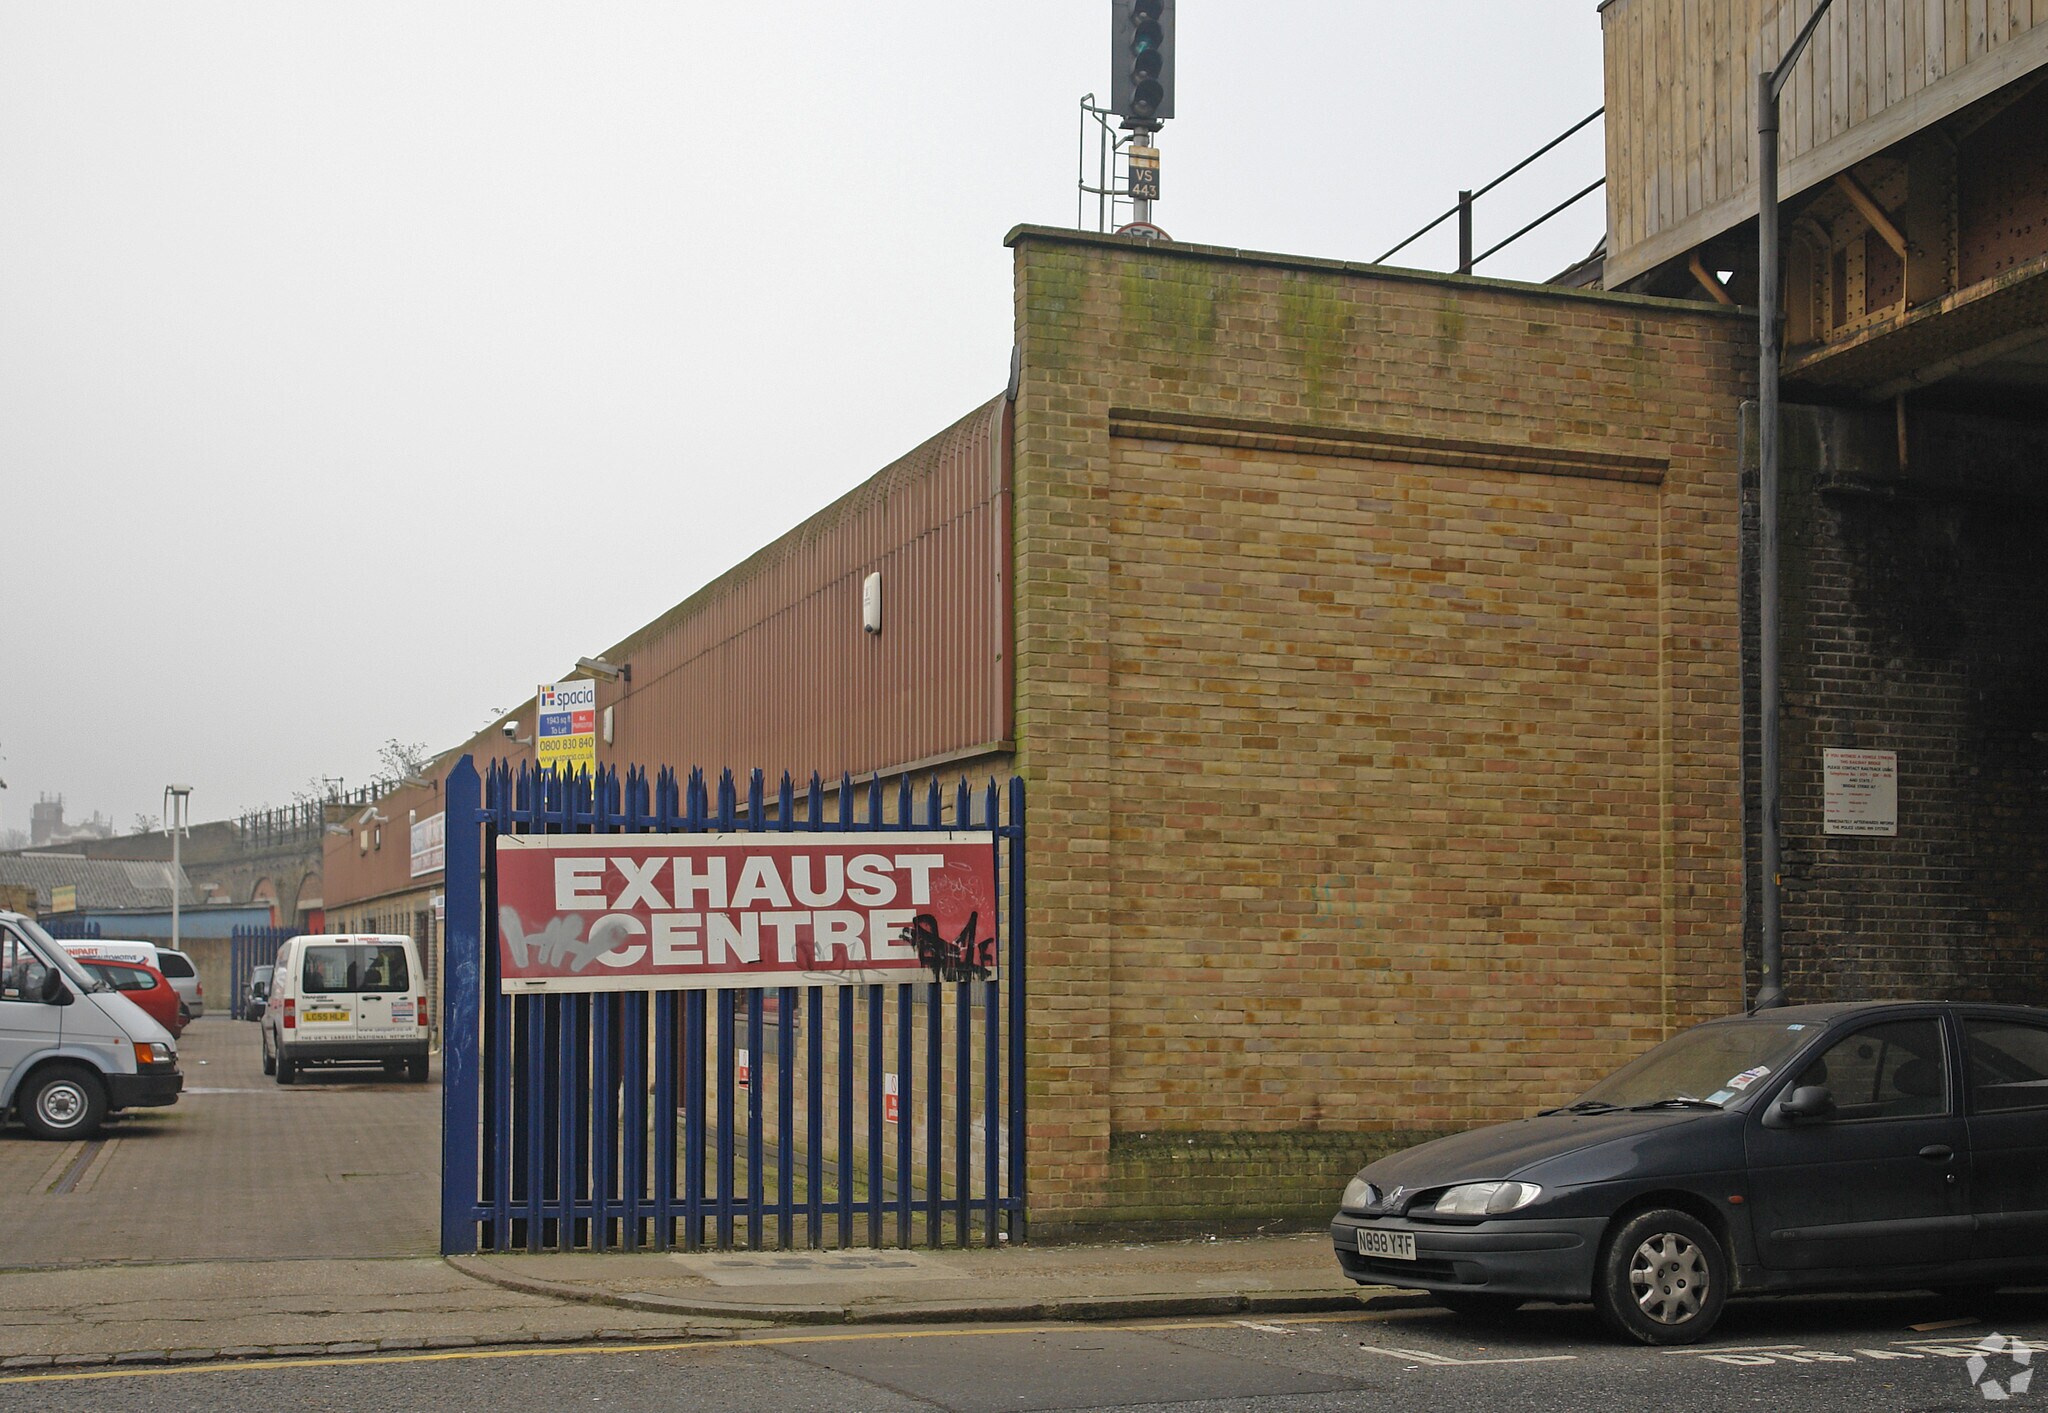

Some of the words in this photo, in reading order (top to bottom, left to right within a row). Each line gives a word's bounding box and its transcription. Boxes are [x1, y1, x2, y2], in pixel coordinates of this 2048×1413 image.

[1136, 169, 1153, 182] VS
[1132, 184, 1157, 197] 443
[557, 686, 593, 711] spacia
[558, 726, 567, 734] Let
[540, 740, 560, 751] 0800
[562, 739, 577, 749] 830
[578, 737, 594, 748] 840
[554, 854, 944, 911] EXHAUST
[588, 908, 919, 968] CENTRE
[1358, 1231, 1388, 1253] N898
[1389, 1234, 1412, 1255] YTF
